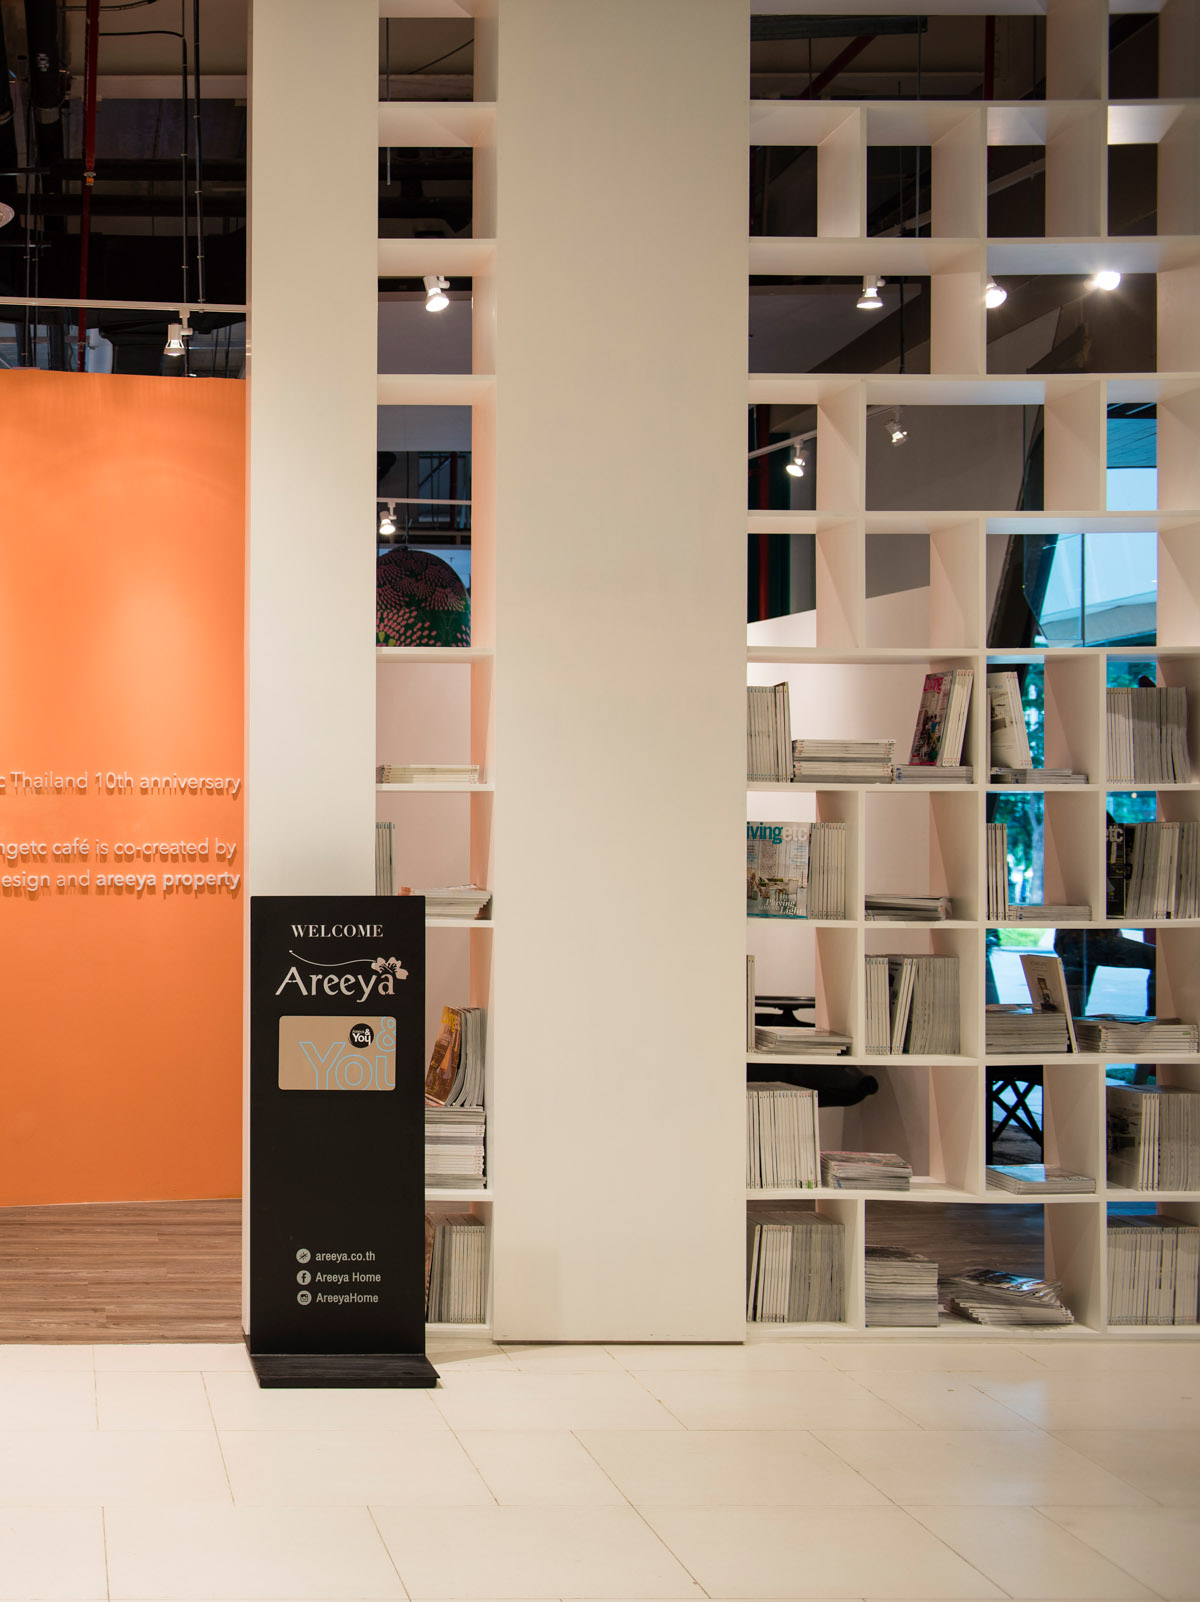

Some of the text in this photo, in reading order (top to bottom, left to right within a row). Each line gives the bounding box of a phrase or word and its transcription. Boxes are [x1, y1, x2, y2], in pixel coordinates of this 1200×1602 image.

[10, 771, 88, 789] Thailand
[95, 772, 134, 789] 10th
[139, 772, 241, 793] anniversary
[747, 821, 808, 845] ivingetc
[52, 838, 90, 855] café
[95, 838, 109, 855] is
[114, 838, 209, 855] co-created
[215, 838, 237, 859] by
[56, 870, 90, 887] and
[96, 874, 157, 891] areeya
[163, 871, 241, 891] property
[291, 924, 384, 938] WELCOME
[275, 966, 396, 1003] Areeya
[315, 1251, 376, 1263] areeya.co.th
[315, 1272, 381, 1284] Areeya Home
[316, 1293, 378, 1304] AreeyaHome
